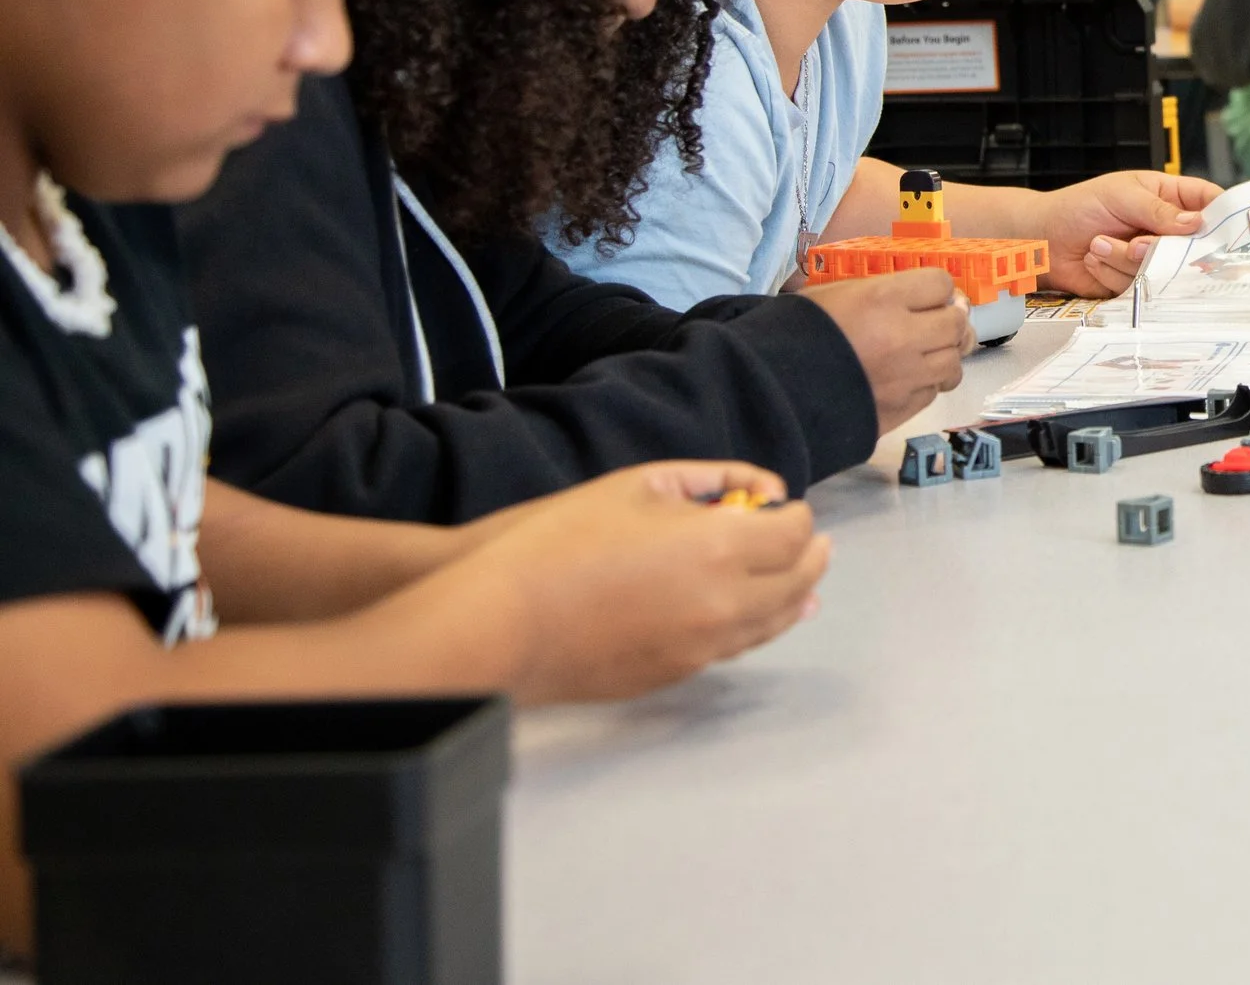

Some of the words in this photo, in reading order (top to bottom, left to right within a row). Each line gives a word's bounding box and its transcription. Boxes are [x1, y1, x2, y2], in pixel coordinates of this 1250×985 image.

[889, 35, 920, 45] Before
[923, 35, 940, 44] You
[943, 34, 970, 46] Begin
